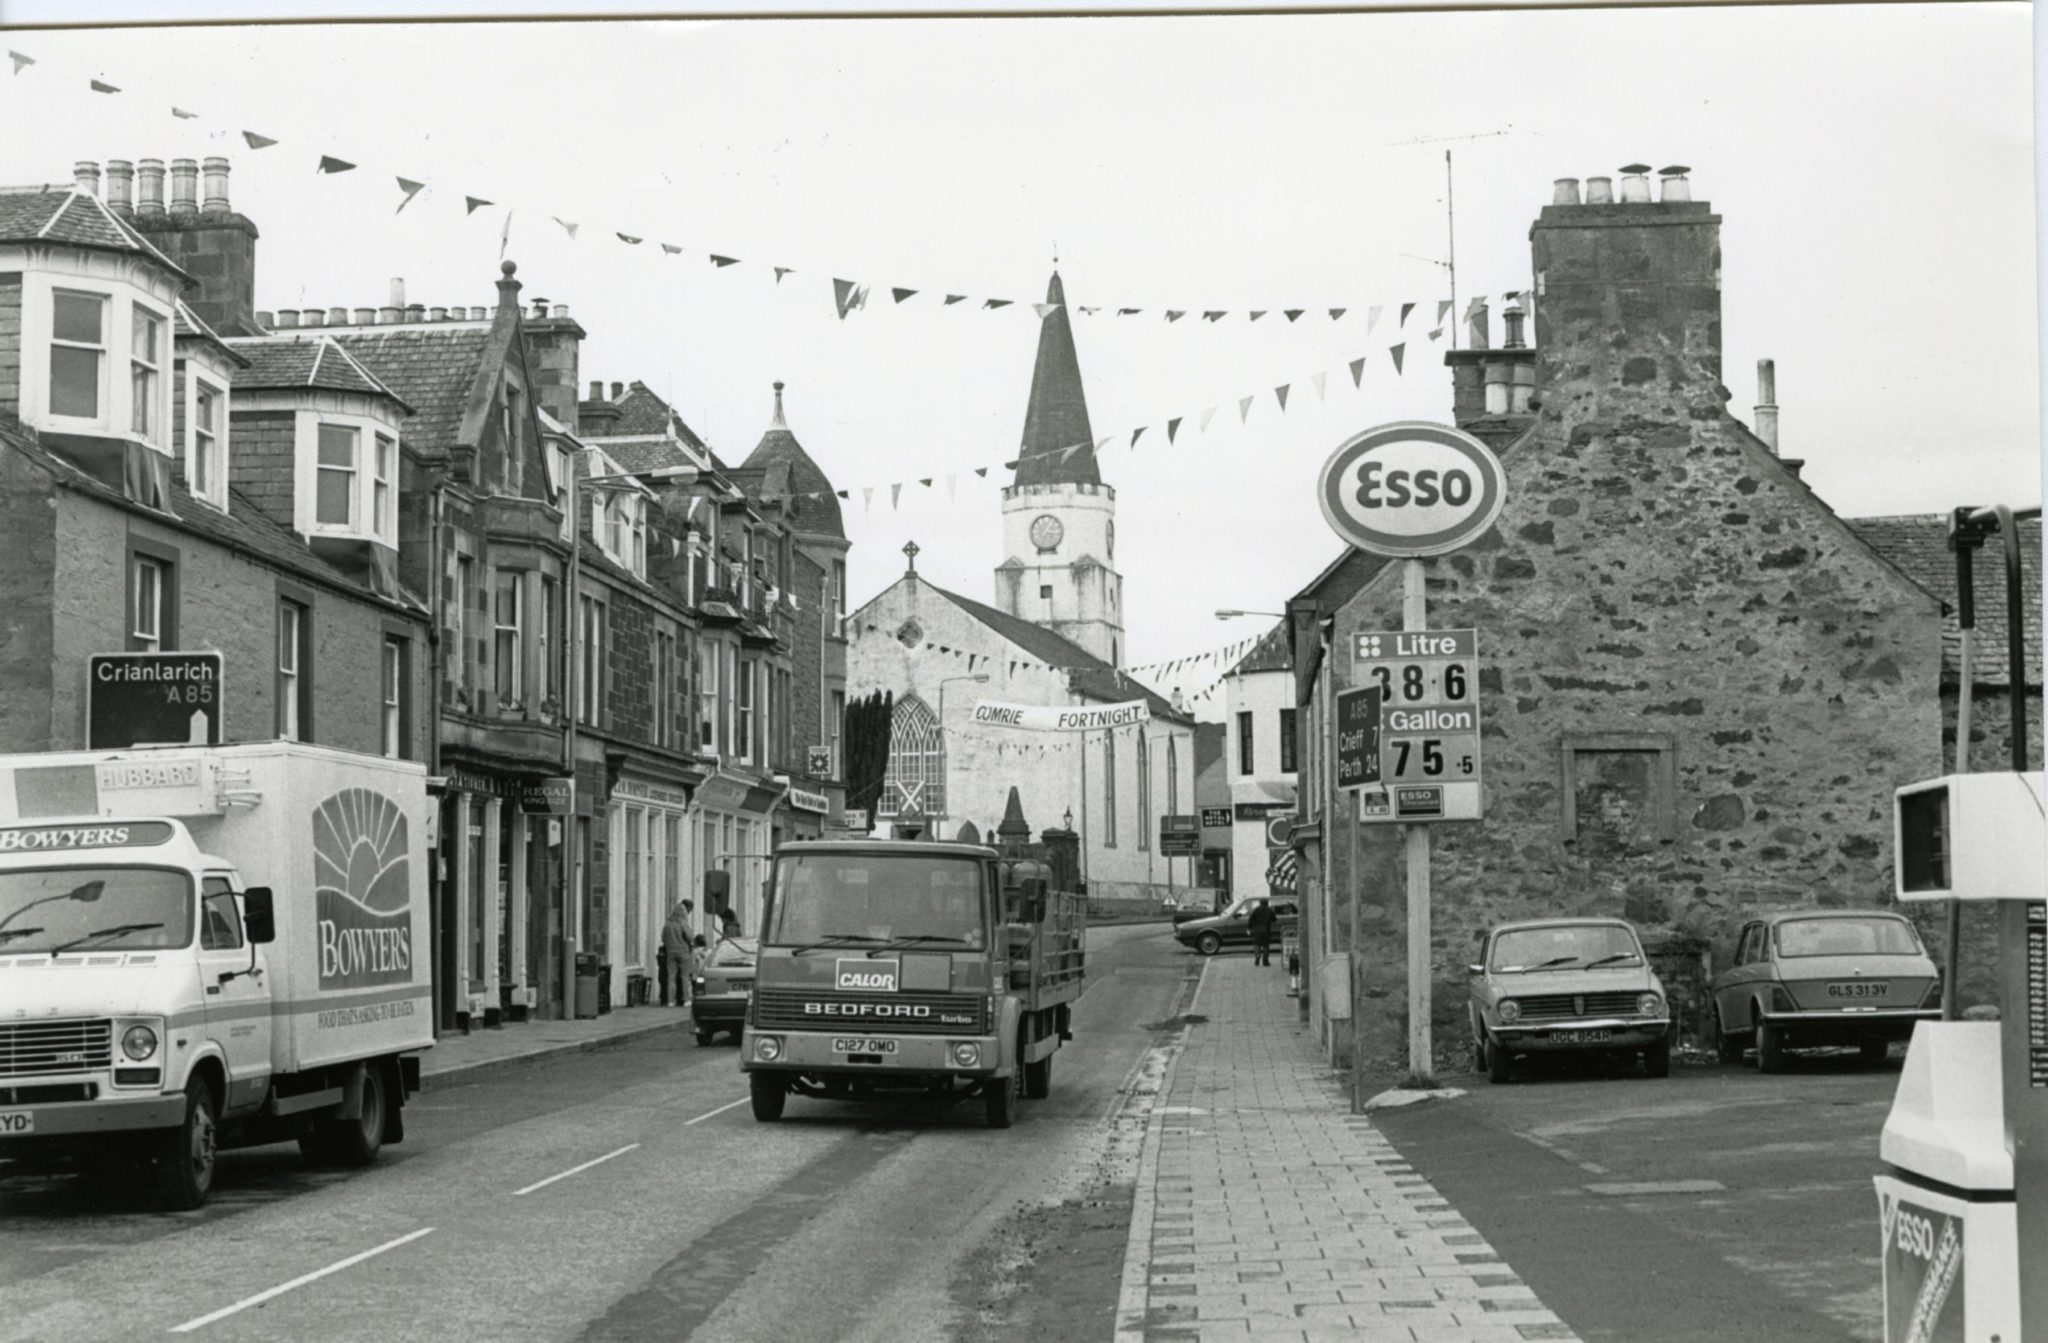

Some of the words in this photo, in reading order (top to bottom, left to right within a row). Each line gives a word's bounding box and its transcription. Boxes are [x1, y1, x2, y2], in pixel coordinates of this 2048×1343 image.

[1396, 635, 1457, 656] Litre
[98, 662, 212, 681] Crianlarich
[976, 705, 1024, 725] COMRIE
[1058, 705, 1142, 728] FORTNIGHT
[1390, 710, 1472, 731] Gallon
[1340, 729, 1364, 752] Crieff
[1372, 726, 1378, 747] 7
[1340, 756, 1362, 779] Perth
[1366, 753, 1378, 775] 24
[523, 787, 570, 797] REGAL
[320, 919, 410, 978] BOWYERS
[840, 972, 894, 991] CALOR
[1828, 984, 1854, 996] GLS
[1855, 984, 1888, 996] 313V
[804, 1003, 930, 1017] BEDFORD
[940, 1014, 972, 1023] turbo
[835, 1039, 866, 1051] C127
[1897, 1209, 1934, 1261] ESSO
